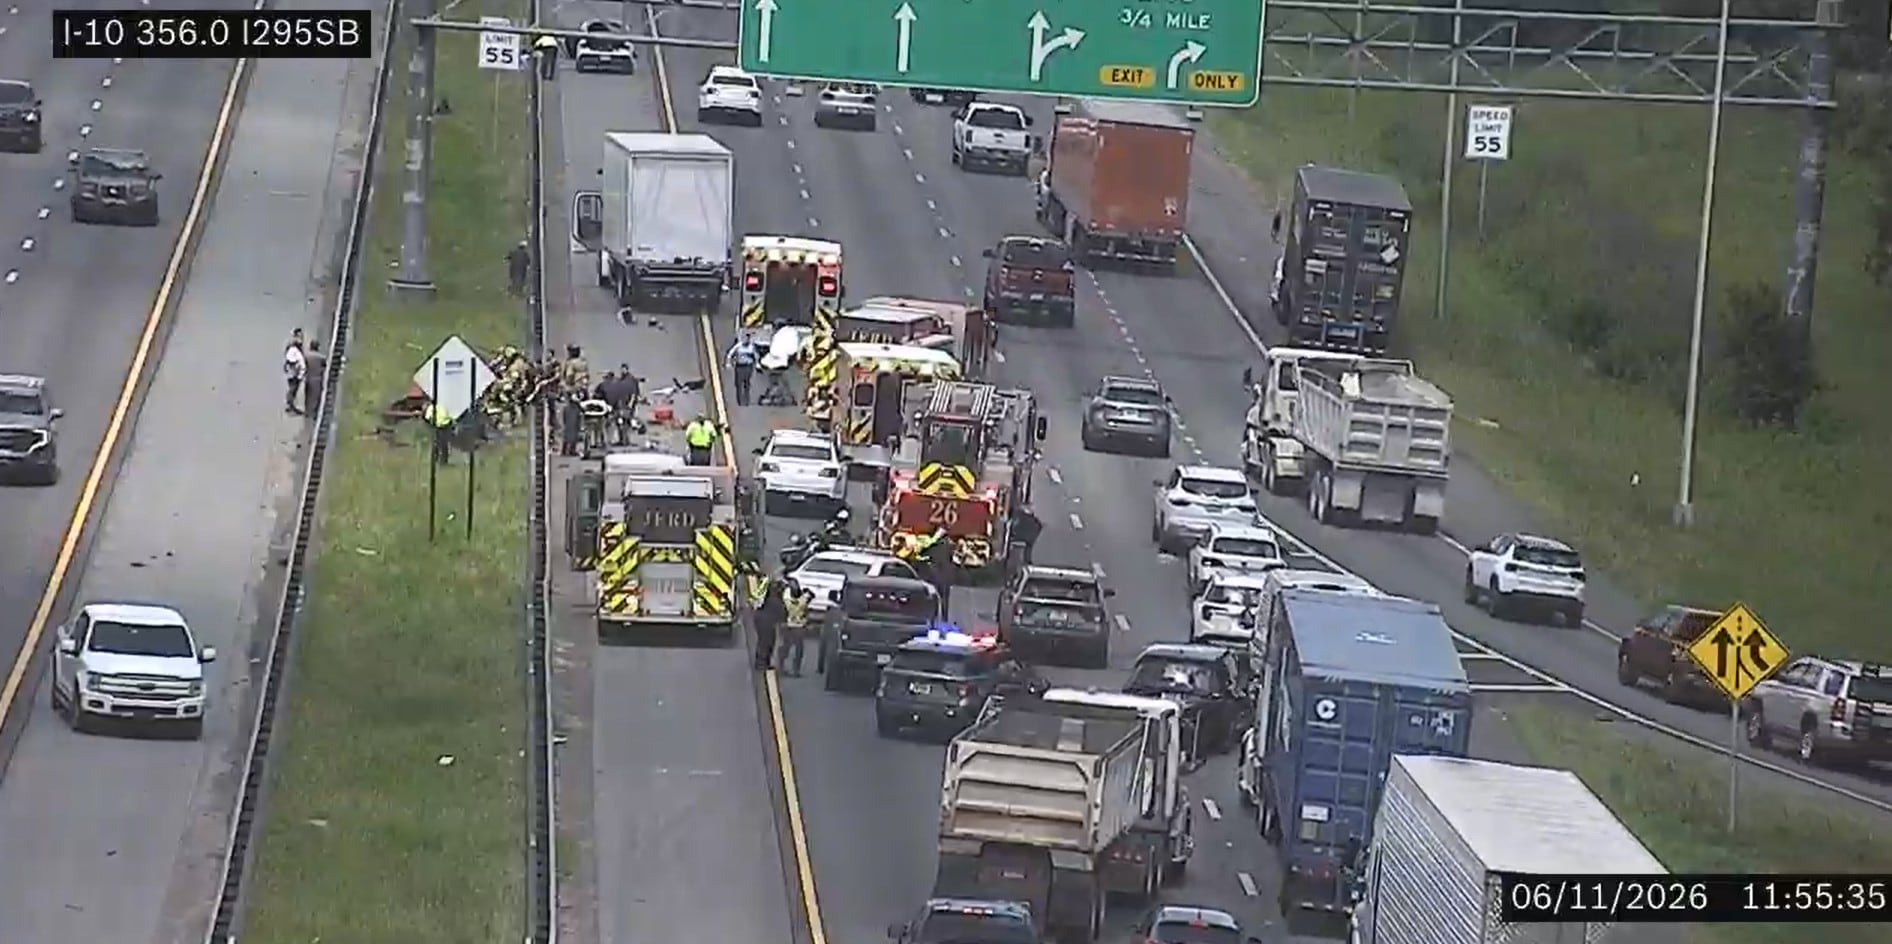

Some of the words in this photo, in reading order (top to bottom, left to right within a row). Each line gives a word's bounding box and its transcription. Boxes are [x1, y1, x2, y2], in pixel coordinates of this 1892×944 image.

[1120, 8, 1151, 28] 3/4
[1166, 12, 1211, 29] MILE
[486, 47, 513, 64] 55
[1112, 68, 1143, 84] EXIT
[1194, 72, 1238, 89] ONLY
[1472, 110, 1509, 121] SPEED
[1475, 123, 1502, 133] LIMIT
[1475, 136, 1501, 152] 55
[643, 511, 695, 528] JFRD
[929, 500, 958, 525] 26
